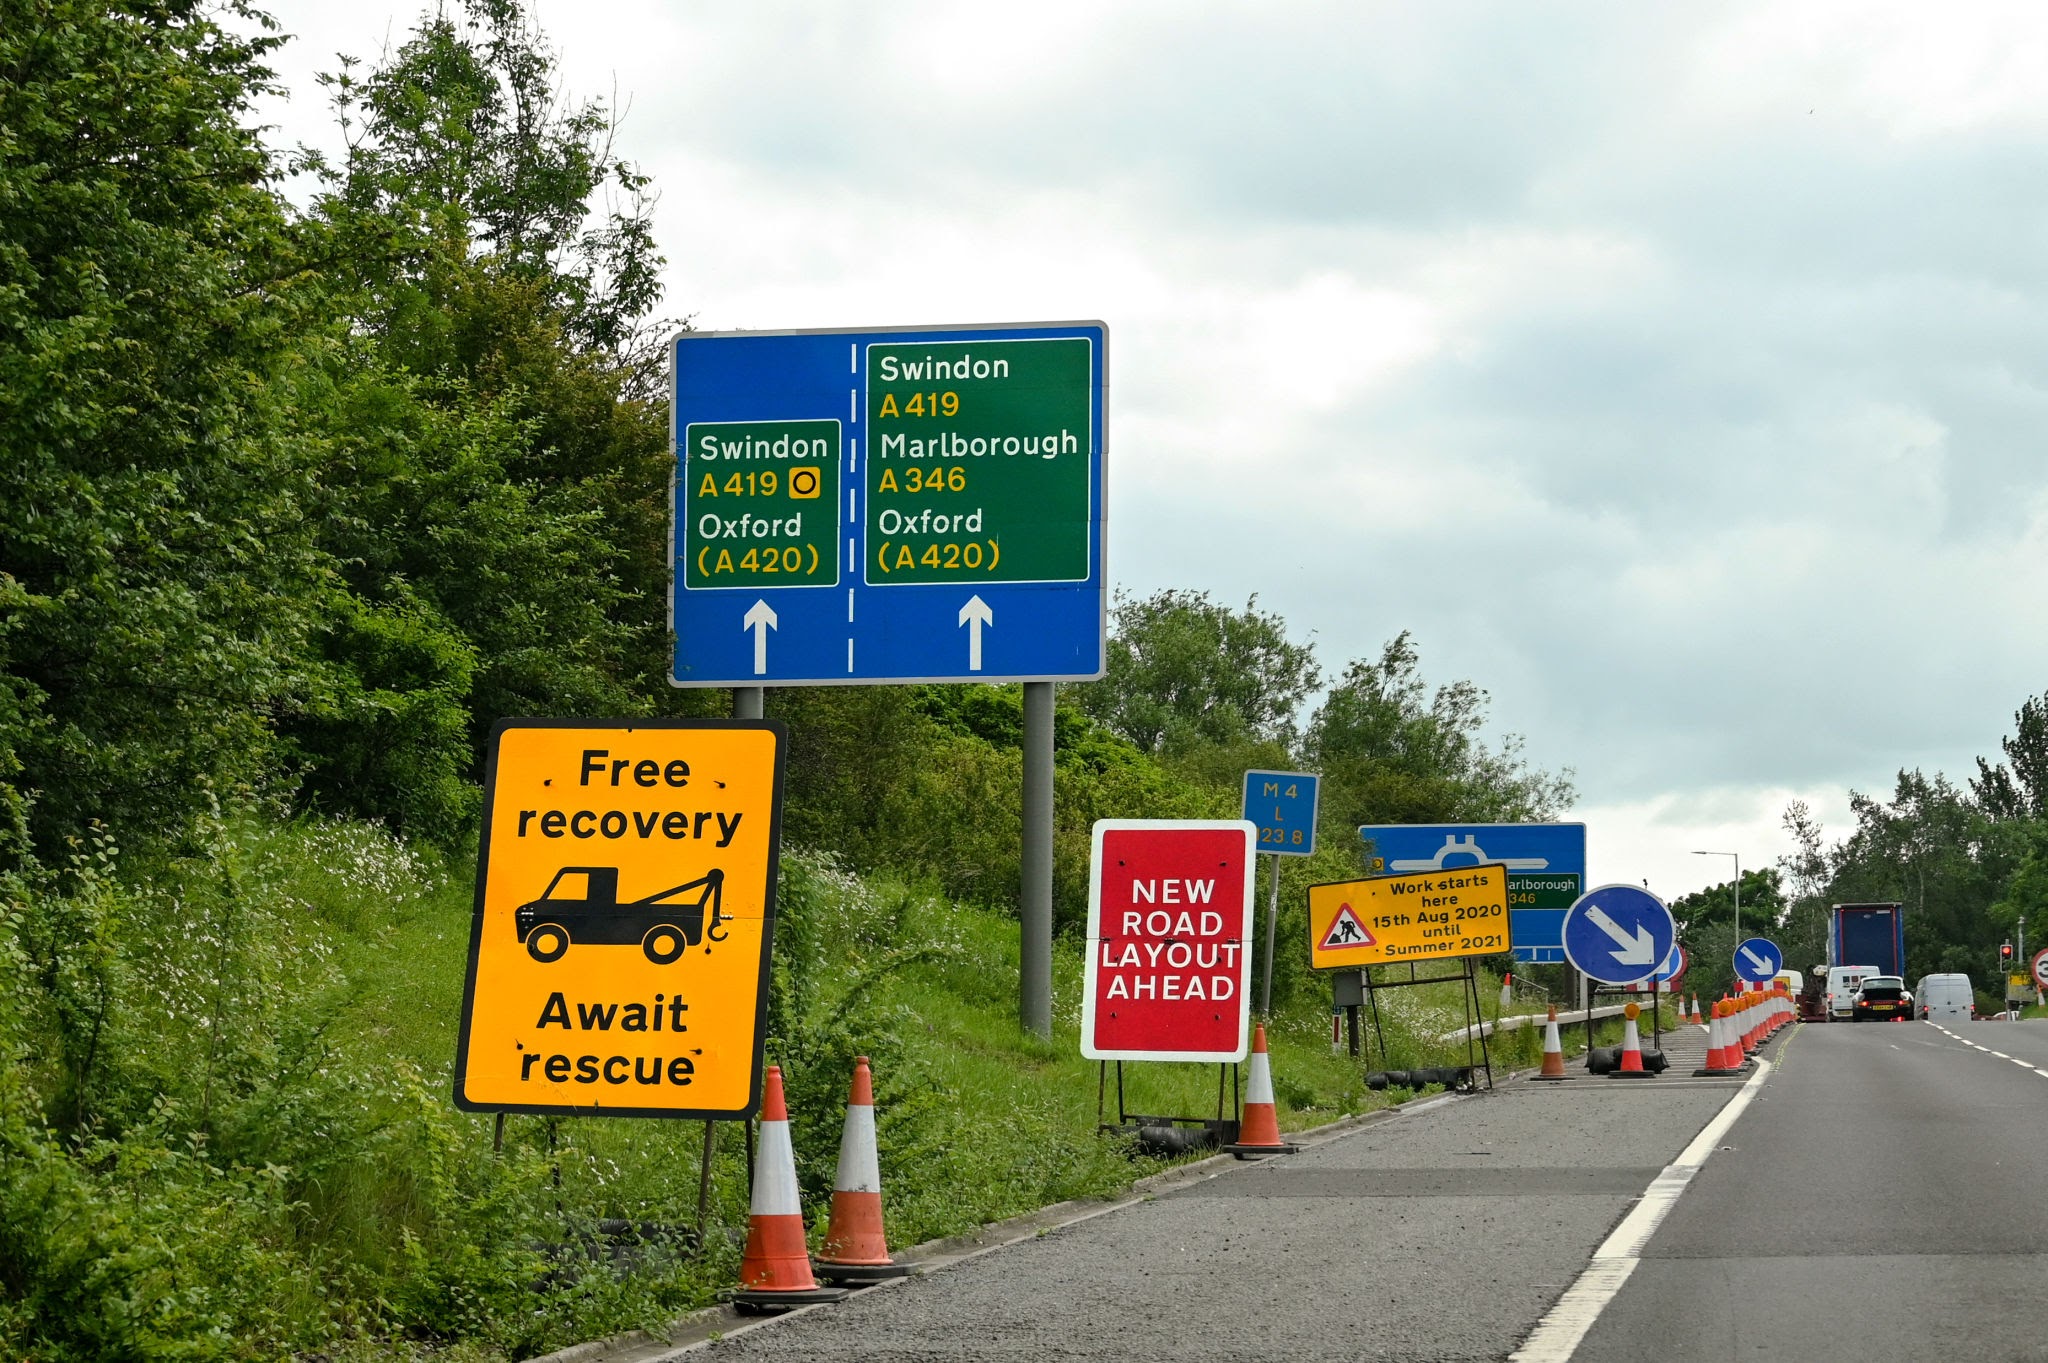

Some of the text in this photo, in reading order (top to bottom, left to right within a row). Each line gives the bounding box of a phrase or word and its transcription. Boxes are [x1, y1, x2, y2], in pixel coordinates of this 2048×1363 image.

[880, 354, 1009, 382] Swindon
[700, 433, 828, 461] Swindon
[881, 428, 1077, 459] Marlborough
[698, 512, 802, 539] Oxford
[878, 507, 983, 536] Oxford
[579, 749, 691, 787] Free
[1275, 806, 1284, 821] L
[517, 808, 743, 848] recovery
[1132, 879, 1215, 904] NEW
[1390, 874, 1489, 896] Work starts
[1509, 879, 1575, 892] arlborough
[1422, 895, 1458, 908] here
[1510, 892, 1536, 904] 346
[1122, 911, 1223, 936] ROAD
[1373, 903, 1502, 928] 15th Aug 2020
[1423, 924, 1461, 938] until
[1102, 942, 1240, 969] LAYOUT
[1385, 935, 1502, 956] Summer 2021
[1106, 975, 1234, 1000] AHEAD
[536, 991, 689, 1032] Await
[520, 1052, 695, 1086] rescue
